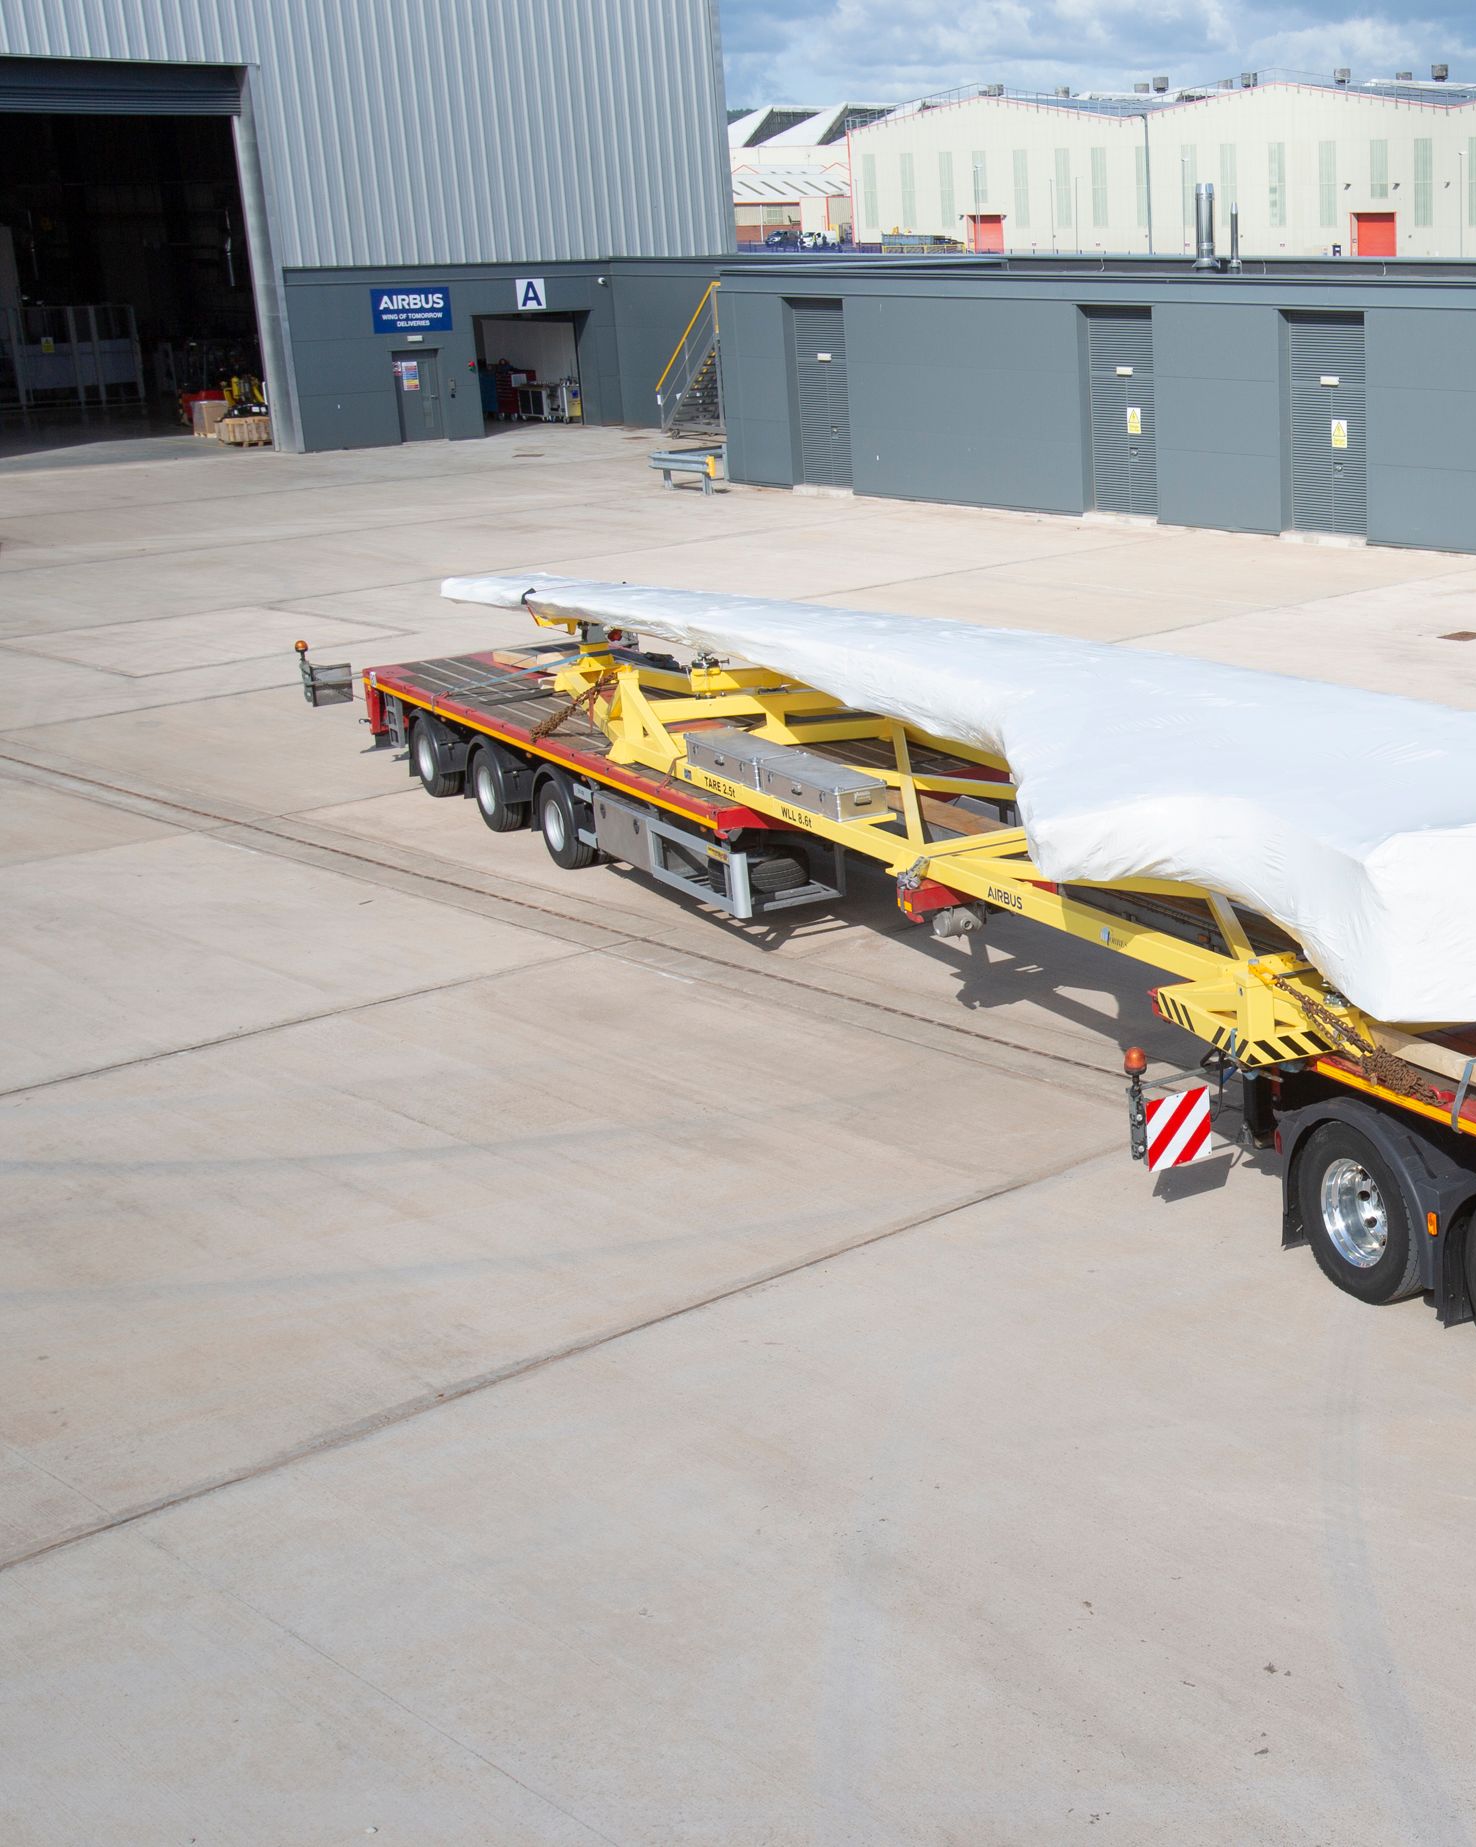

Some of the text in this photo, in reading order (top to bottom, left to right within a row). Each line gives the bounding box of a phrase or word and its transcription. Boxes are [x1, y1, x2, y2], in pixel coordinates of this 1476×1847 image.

[379, 294, 444, 310] AIRBUS
[522, 281, 543, 307] A
[396, 320, 430, 328] DELIVERIES
[408, 312, 443, 320] TOMORROW
[704, 776, 736, 799] TARE 2.5t
[780, 806, 813, 829] WLL 8.6t
[987, 886, 1023, 910] AIRBUS
